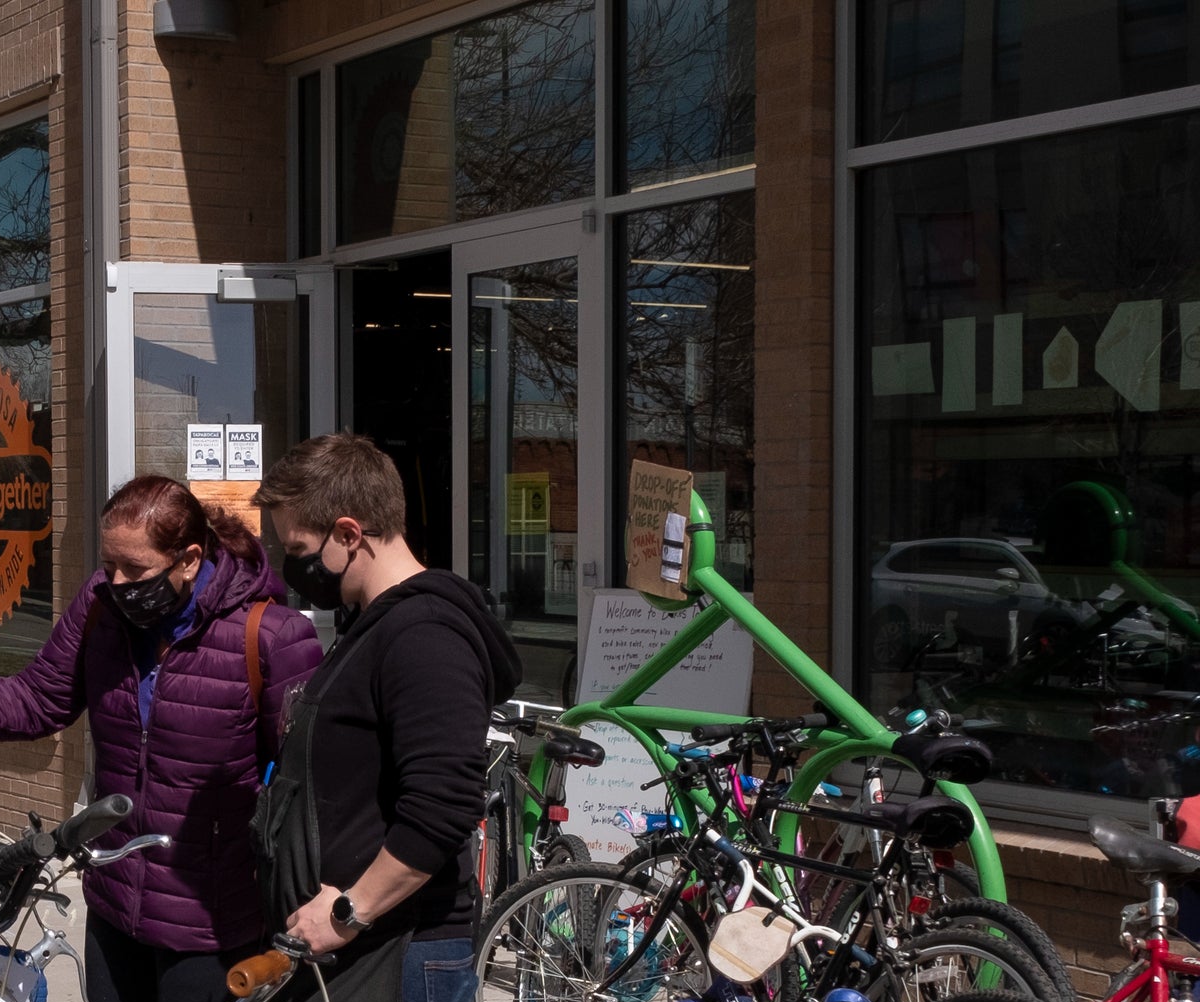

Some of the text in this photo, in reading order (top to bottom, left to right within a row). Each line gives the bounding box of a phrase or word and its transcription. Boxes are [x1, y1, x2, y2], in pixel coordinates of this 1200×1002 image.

[230, 433, 257, 441] MASK
[635, 472, 687, 498] DROP-OFF
[633, 494, 679, 513] DONATIONS
[634, 512, 659, 531] HERE
[6, 544, 24, 587] RIDE
[606, 601, 642, 619] Welcome
[647, 607, 656, 619] to
[608, 777, 634, 790] question
